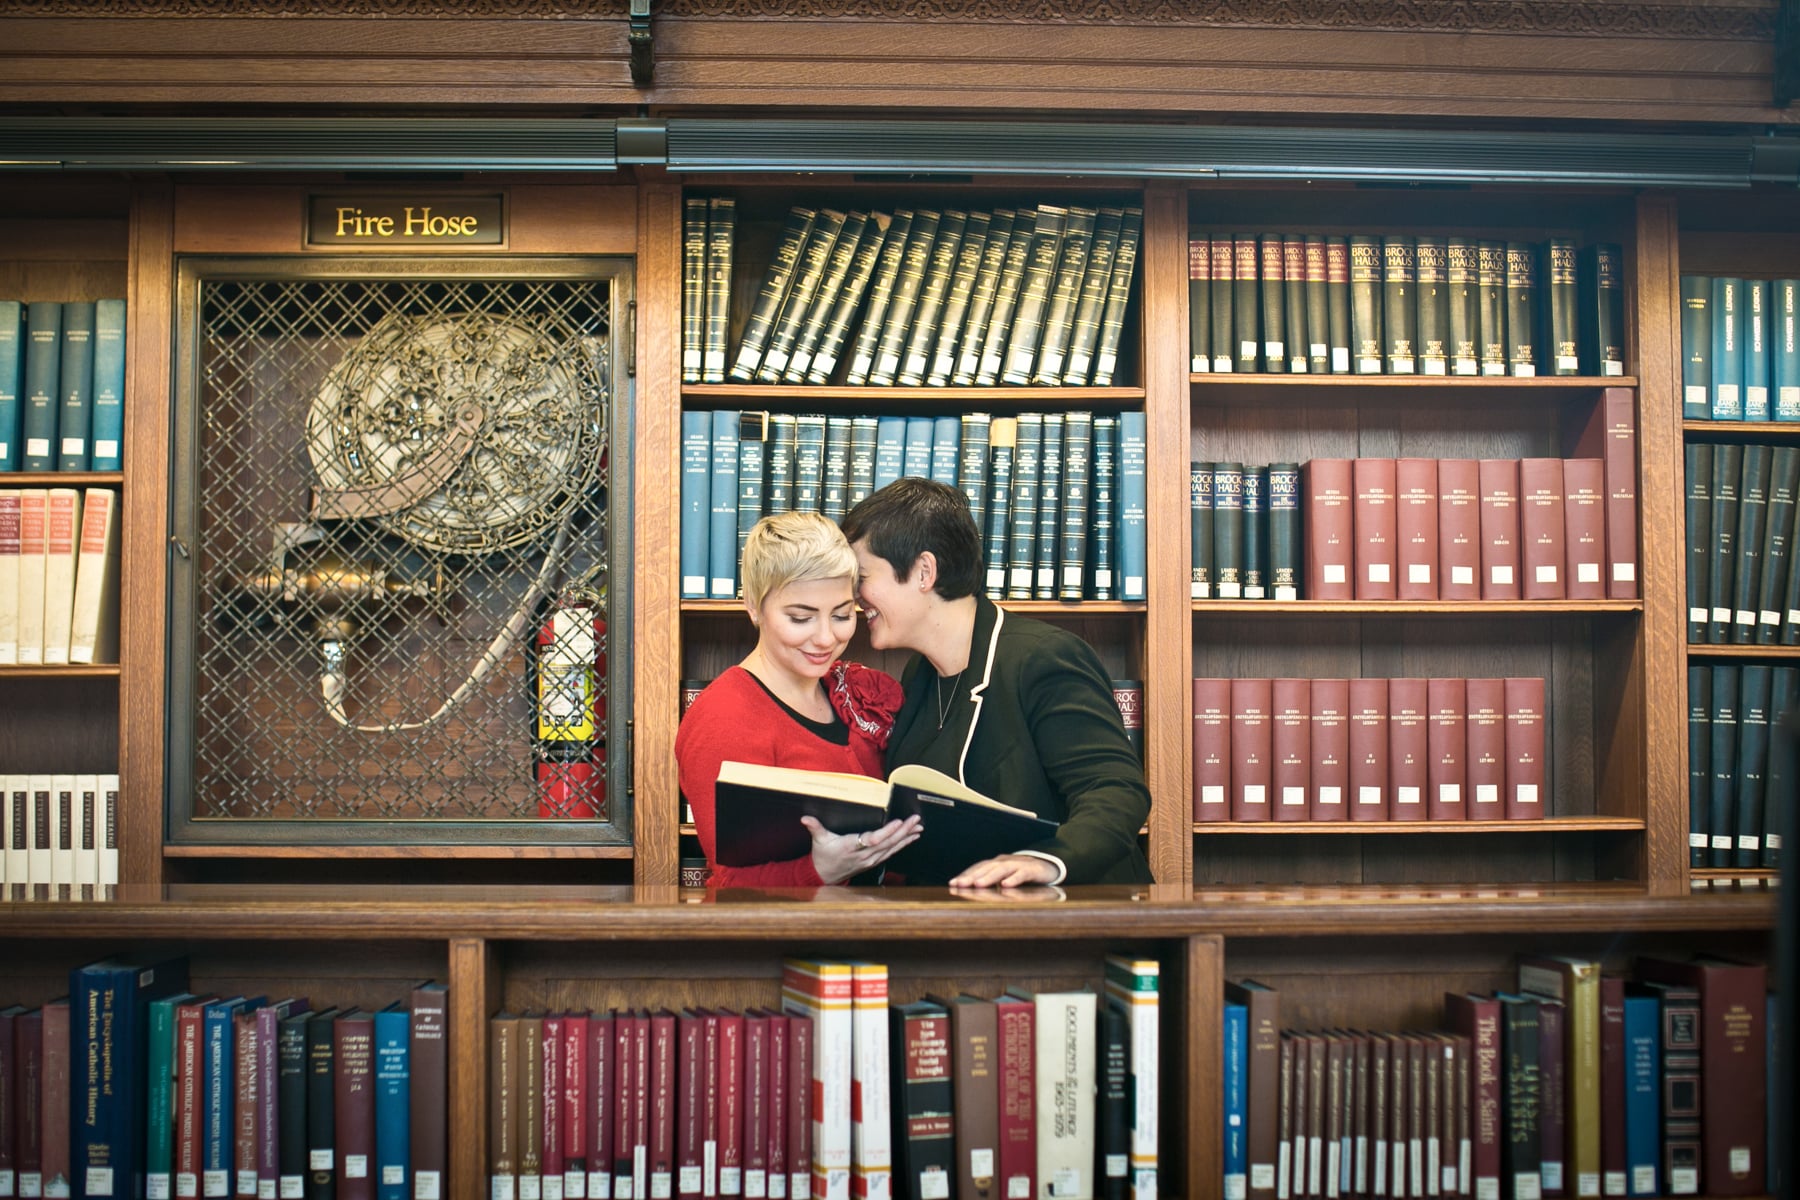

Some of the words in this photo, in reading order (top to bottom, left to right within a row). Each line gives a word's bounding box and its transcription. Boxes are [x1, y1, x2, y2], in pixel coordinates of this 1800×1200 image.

[336, 207, 394, 236] Fire
[403, 207, 478, 236] Hose
[1352, 247, 1380, 257] BROCK
[1385, 247, 1414, 257] BROCK
[1417, 247, 1446, 257] BROCK
[1448, 248, 1477, 258] BROCK
[1479, 251, 1504, 261] BROCK
[1508, 253, 1531, 262] BROC
[1355, 257, 1379, 266] HAUS
[1388, 257, 1412, 266] HAUS
[1421, 257, 1444, 266] HAUS
[1452, 258, 1476, 267] HAUS
[1480, 261, 1504, 270] HAUS
[1511, 262, 1532, 272] HAU
[1554, 258, 1575, 267] HAUS
[1399, 288, 1404, 296] 2
[1215, 474, 1241, 484] BROCK
[1270, 475, 1297, 484] BROCK
[1218, 483, 1240, 493] HAUS
[1243, 487, 1259, 496] HAU
[1273, 483, 1296, 493] HAUS
[1113, 692, 1137, 703] ROC
[682, 870, 708, 881] BROC
[104, 990, 113, 1009] The
[88, 990, 98, 1039] American
[185, 1024, 194, 1039] THE
[213, 1024, 221, 1039] THE
[1478, 1016, 1497, 1046] The
[102, 1012, 113, 1081] Encyclopedia
[239, 1027, 247, 1053] AND
[248, 1029, 257, 1053] THE
[1003, 1012, 1019, 1067] CATHOLIC
[1017, 1012, 1031, 1077] CATECHISM
[88, 1042, 98, 1084] Catholic
[184, 1041, 194, 1076] AMERICAN
[211, 1041, 221, 1076] AMERICAN
[239, 1055, 248, 1077] THE
[1475, 1048, 1497, 1085] Book
[103, 1084, 112, 1095] of
[184, 1078, 194, 1111] CATHOLIC
[212, 1078, 221, 1111] CATHOLIC
[1005, 1069, 1019, 1116] CHURCH
[1018, 1080, 1030, 1094] OF
[86, 1087, 98, 1126] History
[1018, 1099, 1031, 1121] THE
[1067, 1090, 1078, 1137] LITURGY
[1509, 1072, 1528, 1142] SAINTS
[1480, 1099, 1498, 1145] Saints
